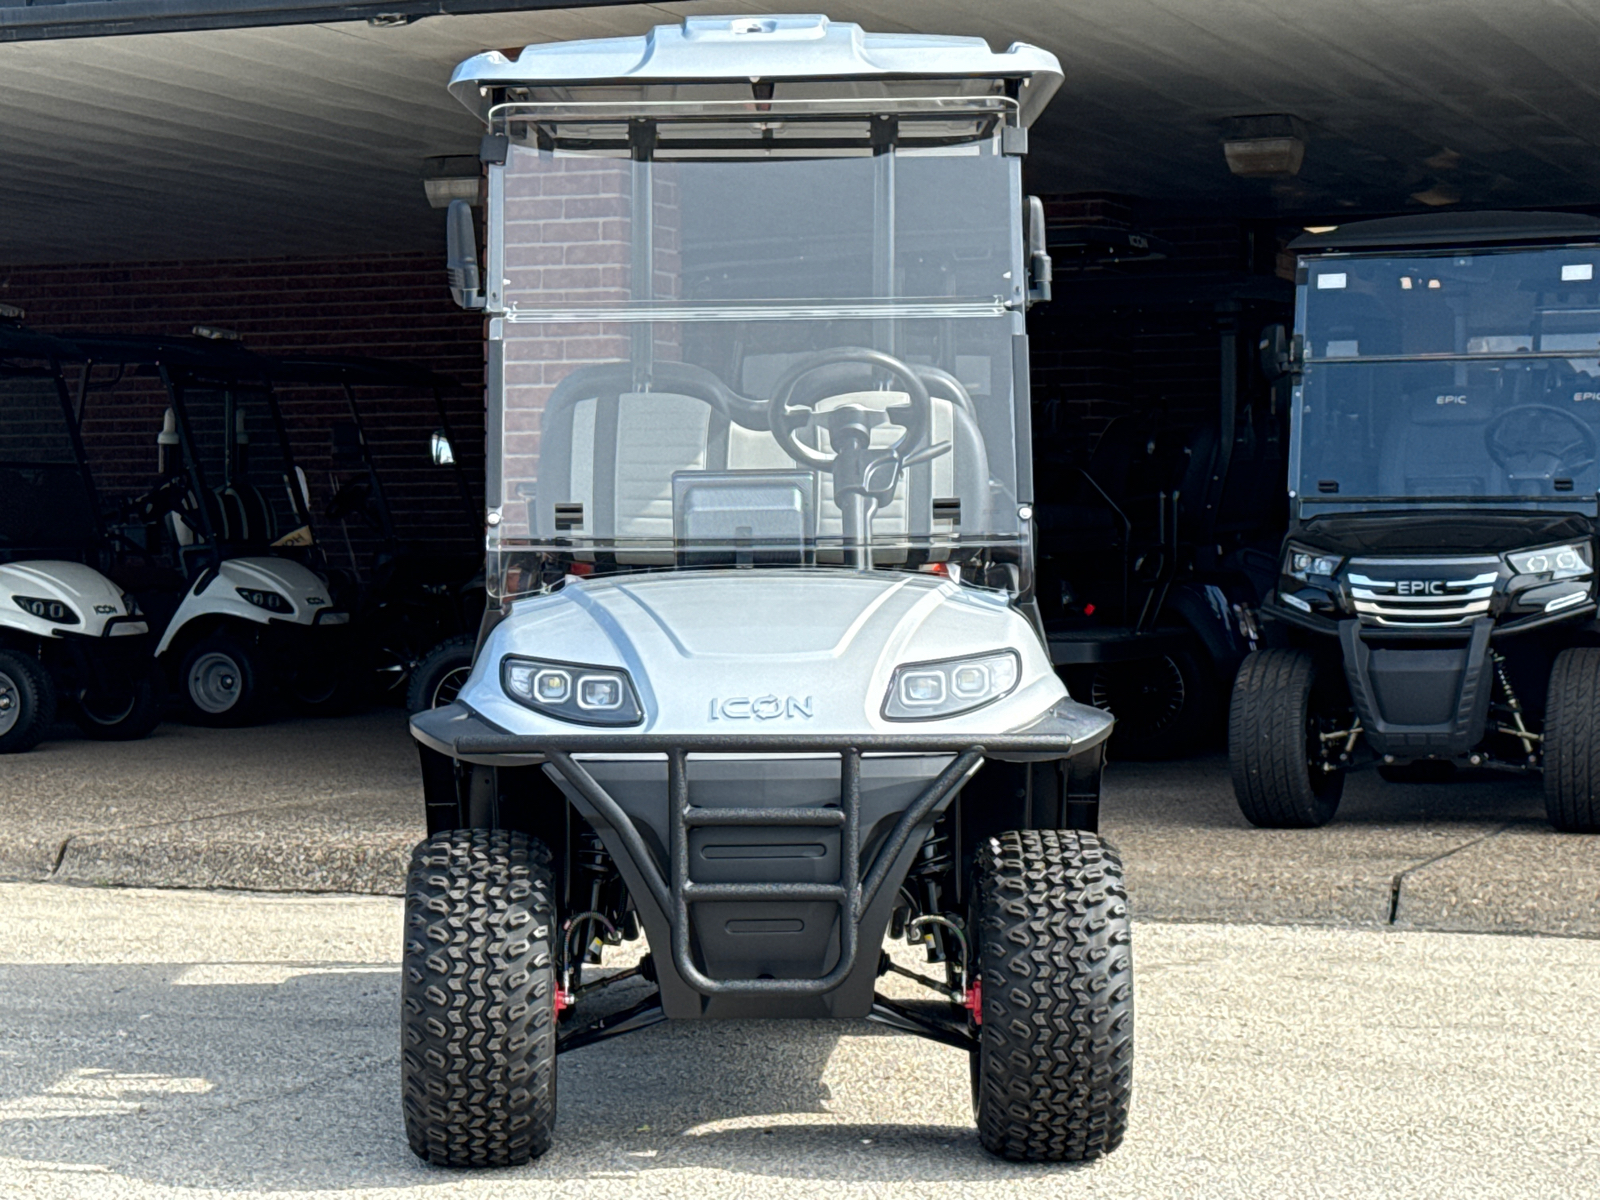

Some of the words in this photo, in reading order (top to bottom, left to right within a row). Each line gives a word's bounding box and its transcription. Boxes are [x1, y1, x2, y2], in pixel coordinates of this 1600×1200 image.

[1436, 395, 1467, 405] EPIC
[1397, 581, 1444, 595] EPIC
[93, 604, 118, 615] ICON
[707, 694, 813, 722] ICON
